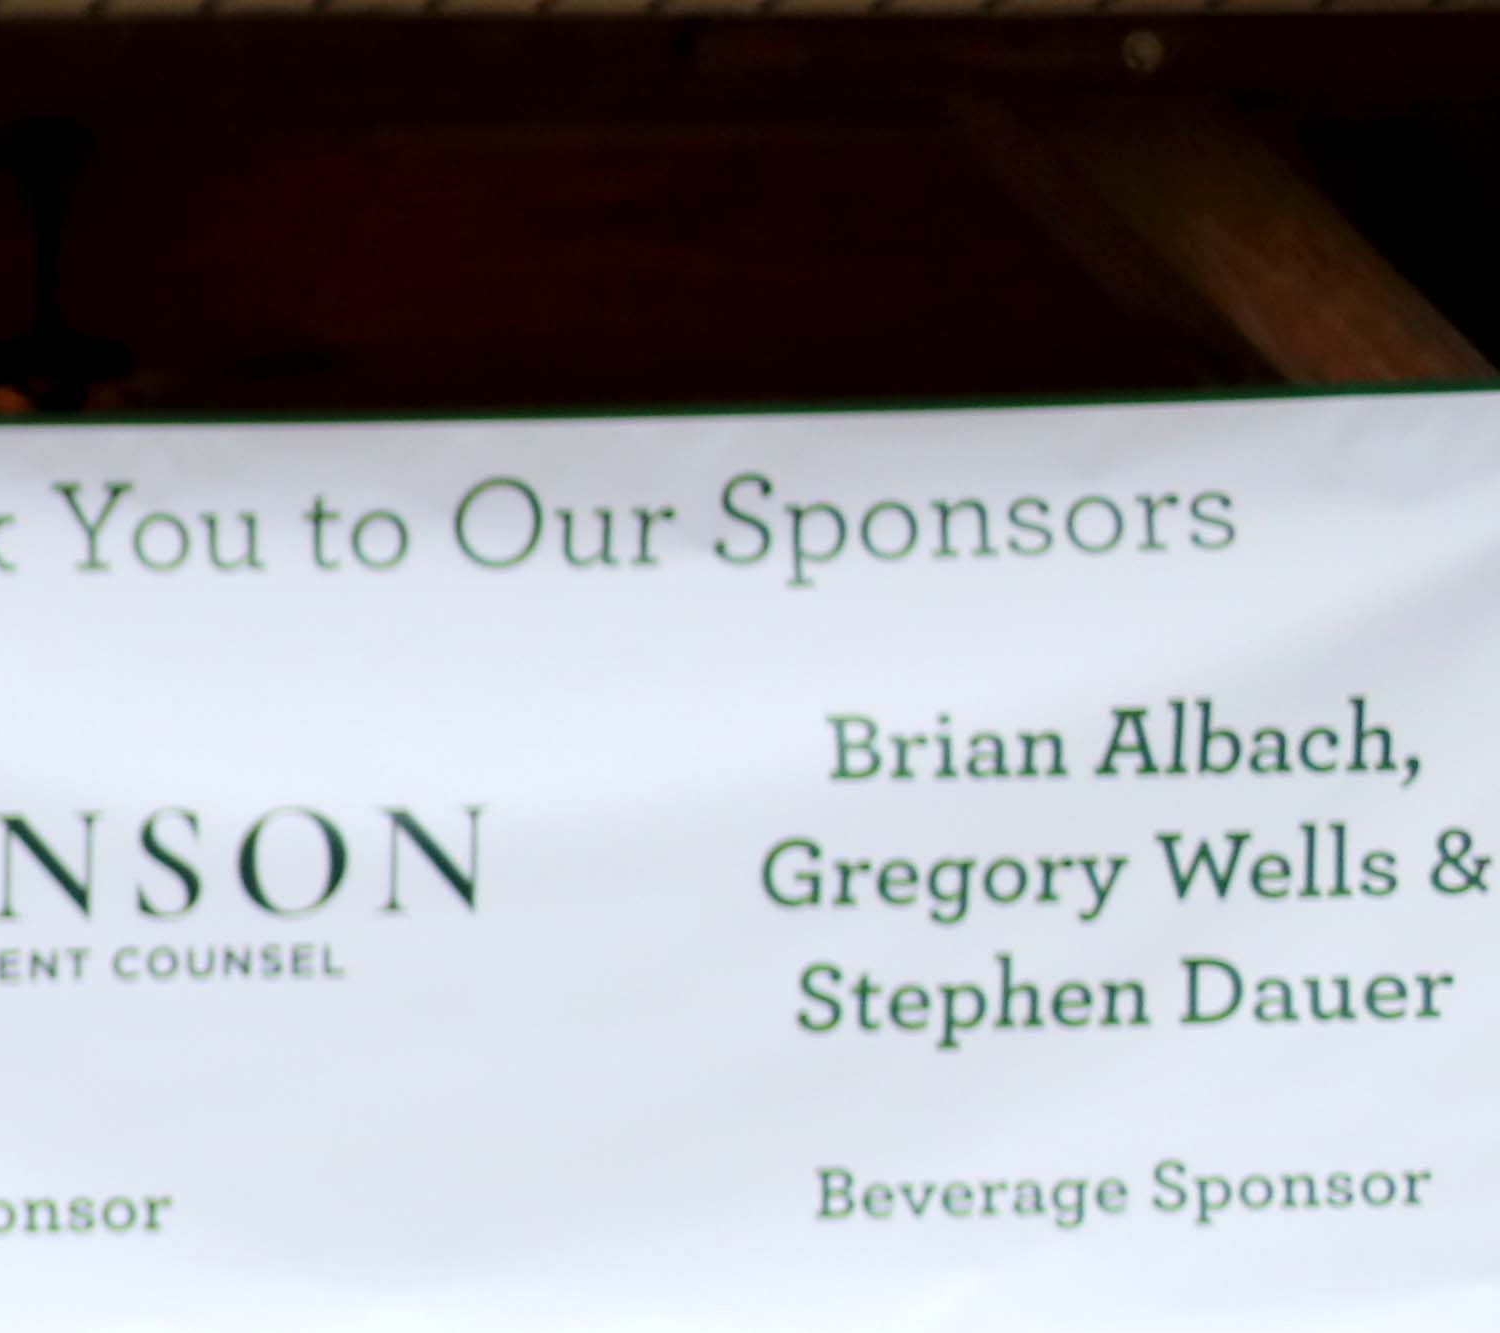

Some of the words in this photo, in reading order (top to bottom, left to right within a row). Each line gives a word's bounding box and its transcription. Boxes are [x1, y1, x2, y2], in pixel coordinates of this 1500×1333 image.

[50, 480, 266, 573] You
[302, 494, 406, 572] to
[452, 476, 677, 570] Our
[711, 471, 1239, 588] Sponsors
[827, 713, 1069, 782] Brian
[1094, 696, 1422, 786] Albach,
[760, 837, 1129, 926] Gregory
[1155, 821, 1399, 901] Wells
[1429, 827, 1493, 896] &
[111, 942, 345, 982] COUNSEL
[796, 952, 1151, 1051] Stephen
[1179, 956, 1456, 1026] Dauer
[816, 1166, 1130, 1230] Beverage
[1151, 1158, 1434, 1227] Sponsor
